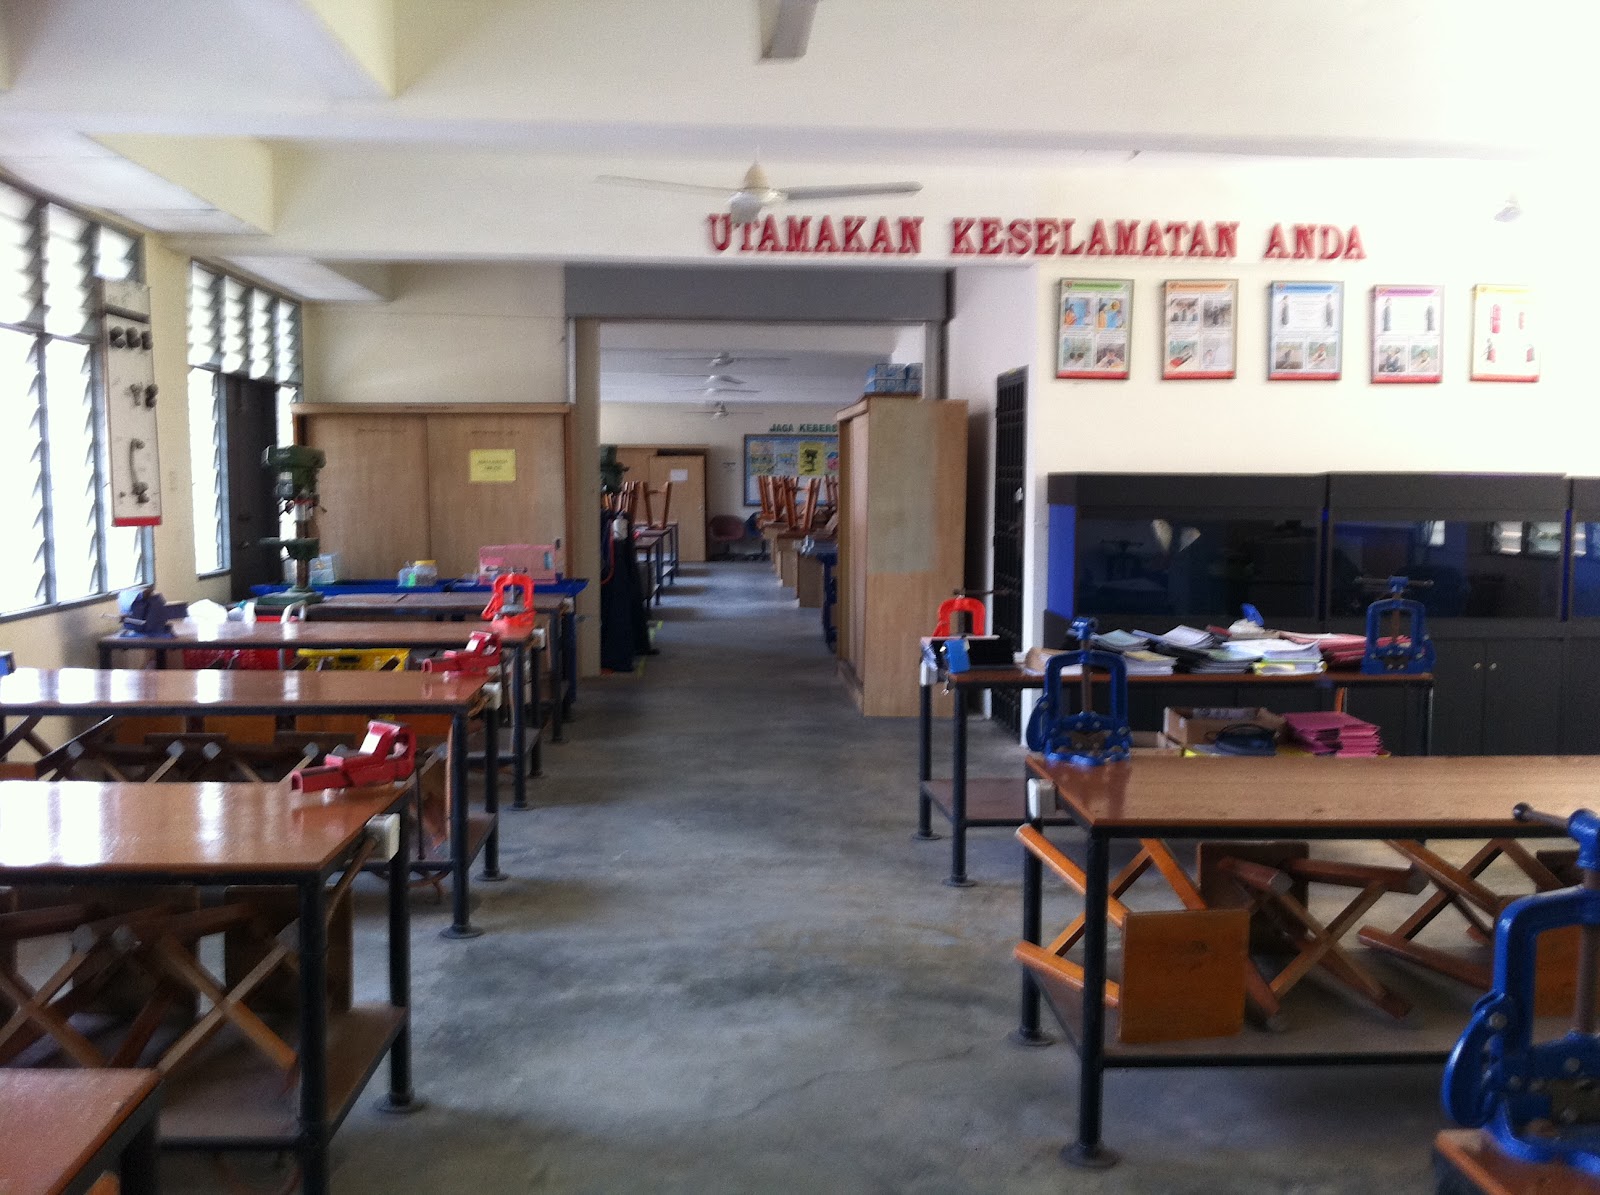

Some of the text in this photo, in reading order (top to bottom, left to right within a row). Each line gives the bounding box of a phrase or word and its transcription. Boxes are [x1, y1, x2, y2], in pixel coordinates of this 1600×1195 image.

[707, 213, 1367, 260] UTAMAKAN KESELAMATAN ANDA
[769, 423, 794, 432] JAGA
